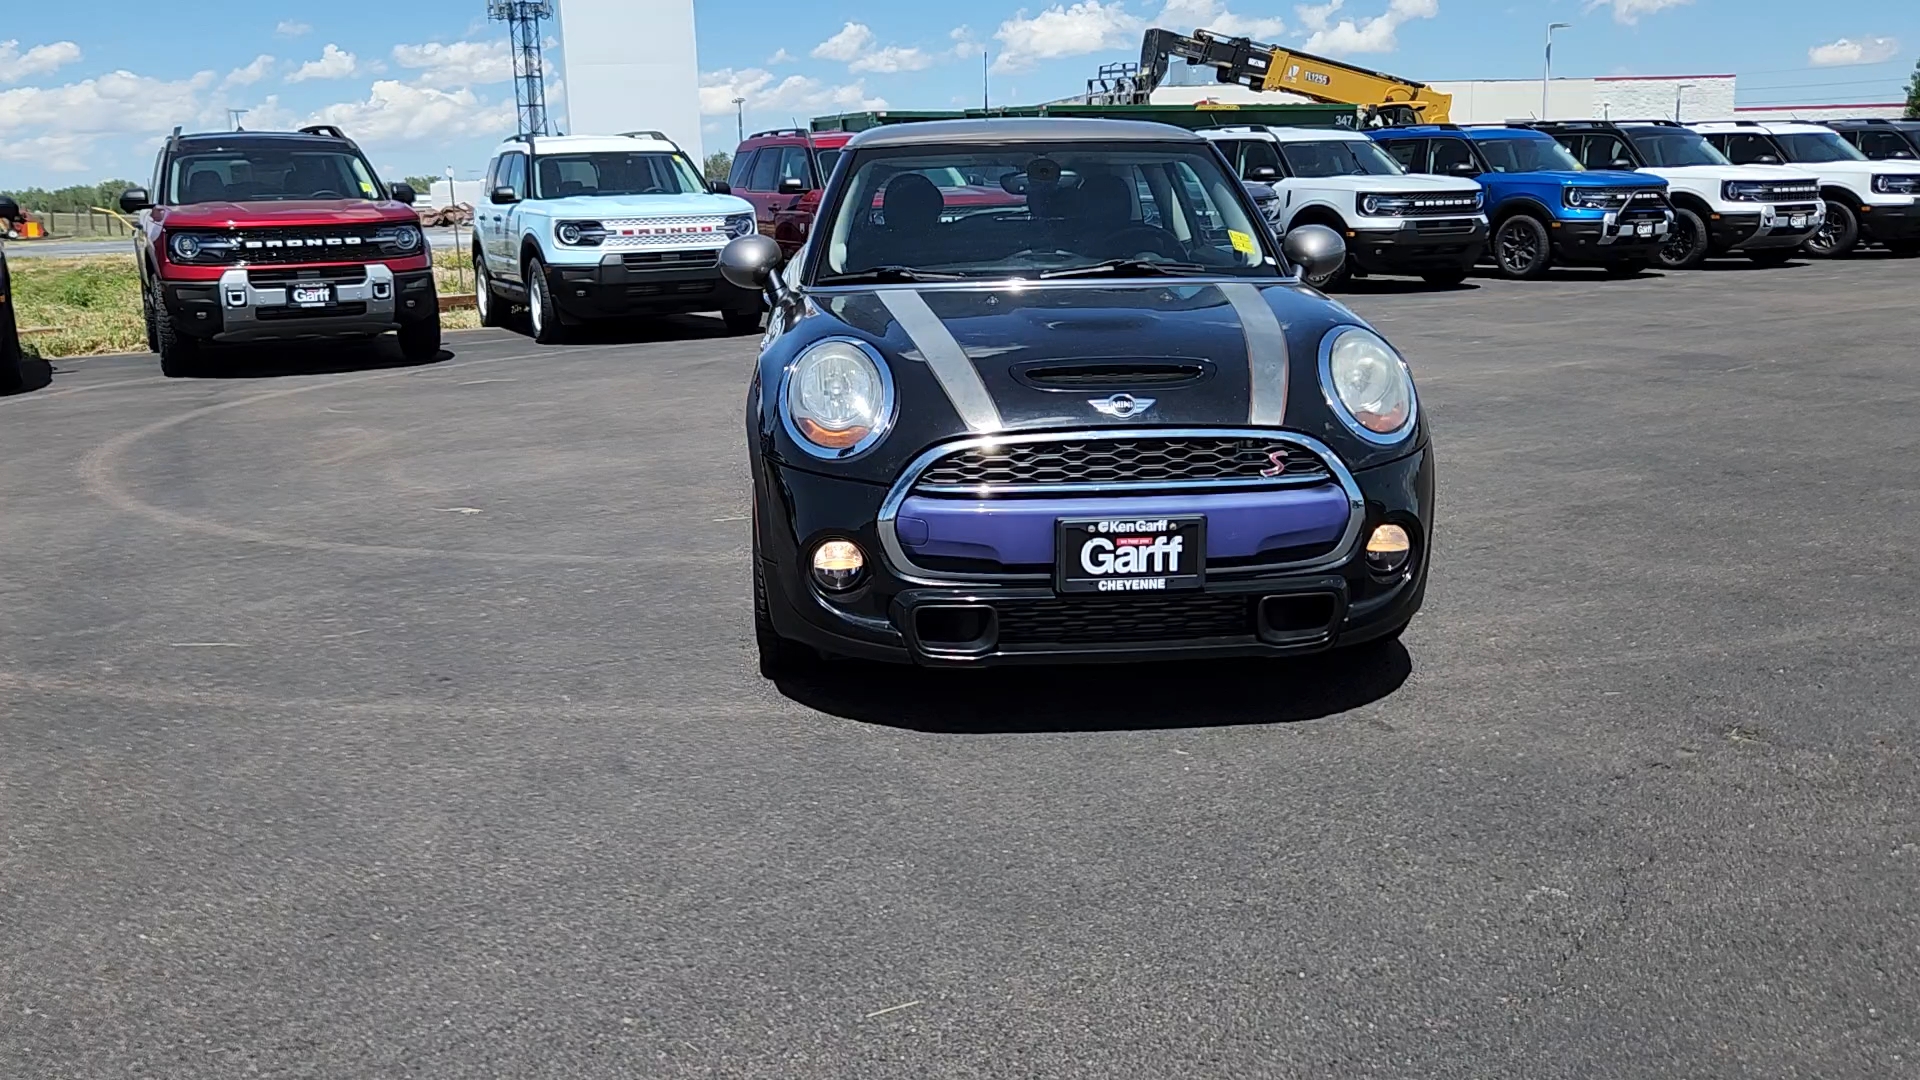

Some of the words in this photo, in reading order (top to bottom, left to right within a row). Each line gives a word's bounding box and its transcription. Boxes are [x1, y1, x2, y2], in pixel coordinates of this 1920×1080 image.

[1304, 71, 1329, 86] TL1255
[1335, 115, 1353, 126] 347
[245, 237, 361, 248] BRONCO
[293, 288, 330, 302] Garff
[1111, 400, 1133, 408] MINI
[1260, 450, 1288, 477] S
[1109, 521, 1135, 533] Ken
[1135, 519, 1168, 533] Garff
[1080, 535, 1183, 575] Garff
[1098, 578, 1166, 591] CHEYENNE
